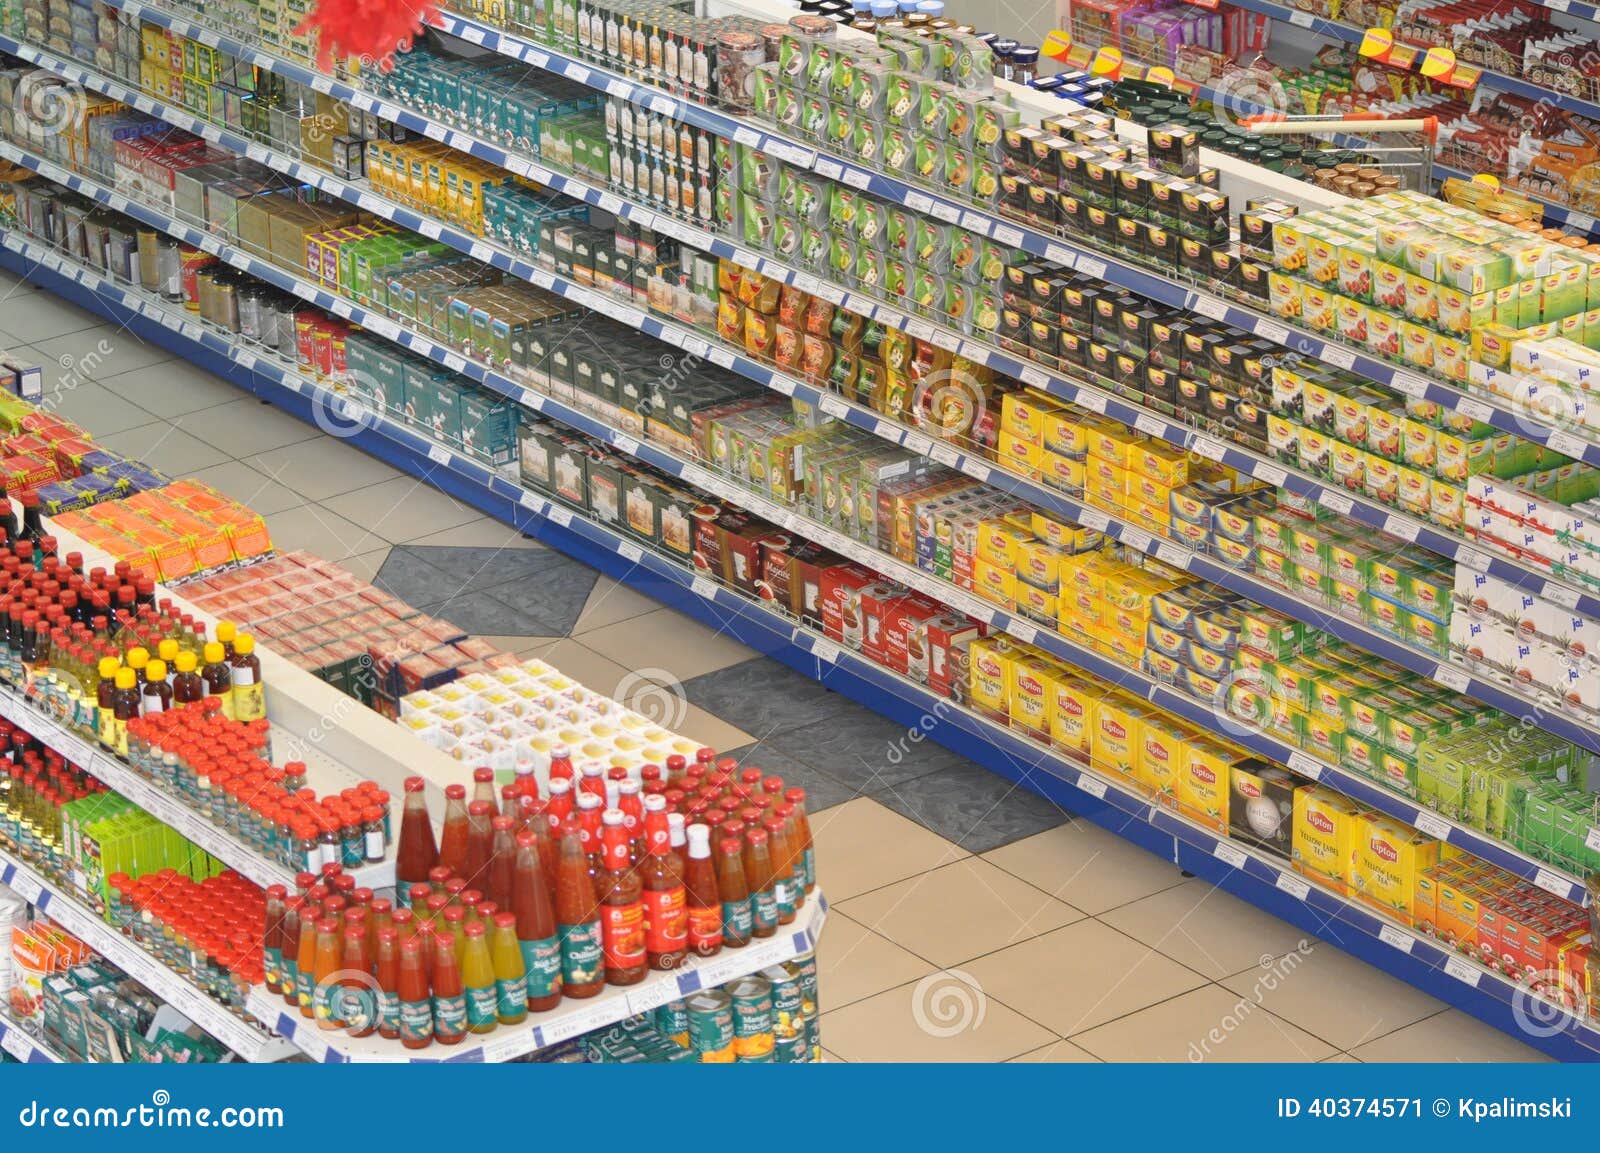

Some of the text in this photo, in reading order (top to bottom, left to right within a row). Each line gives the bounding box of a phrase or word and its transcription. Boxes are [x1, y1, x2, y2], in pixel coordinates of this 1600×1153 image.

[1529, 352, 1539, 363] ja!
[1486, 369, 1496, 381] ja!
[1578, 368, 1590, 380] ja!
[1484, 485, 1493, 495] ja!
[1527, 502, 1537, 513] ja!
[1481, 516, 1491, 526] ja!
[1574, 520, 1583, 531] ja!
[1524, 534, 1534, 544] ja!
[1569, 553, 1578, 563] ja!
[1475, 575, 1486, 588] ja!
[1522, 596, 1533, 608] ja!
[1572, 618, 1583, 630] ja!
[1470, 625, 1481, 636] ja!
[1518, 646, 1530, 658] ja!
[1568, 669, 1579, 681] ja!
[1019, 678, 1042, 695] Lipton
[1059, 697, 1082, 714] Lipton
[1103, 721, 1125, 738] Lipton
[1147, 742, 1168, 759] Lipton
[1192, 765, 1215, 782] Lipton
[1308, 814, 1333, 833] Lipton
[1371, 840, 1397, 860] Lipton
